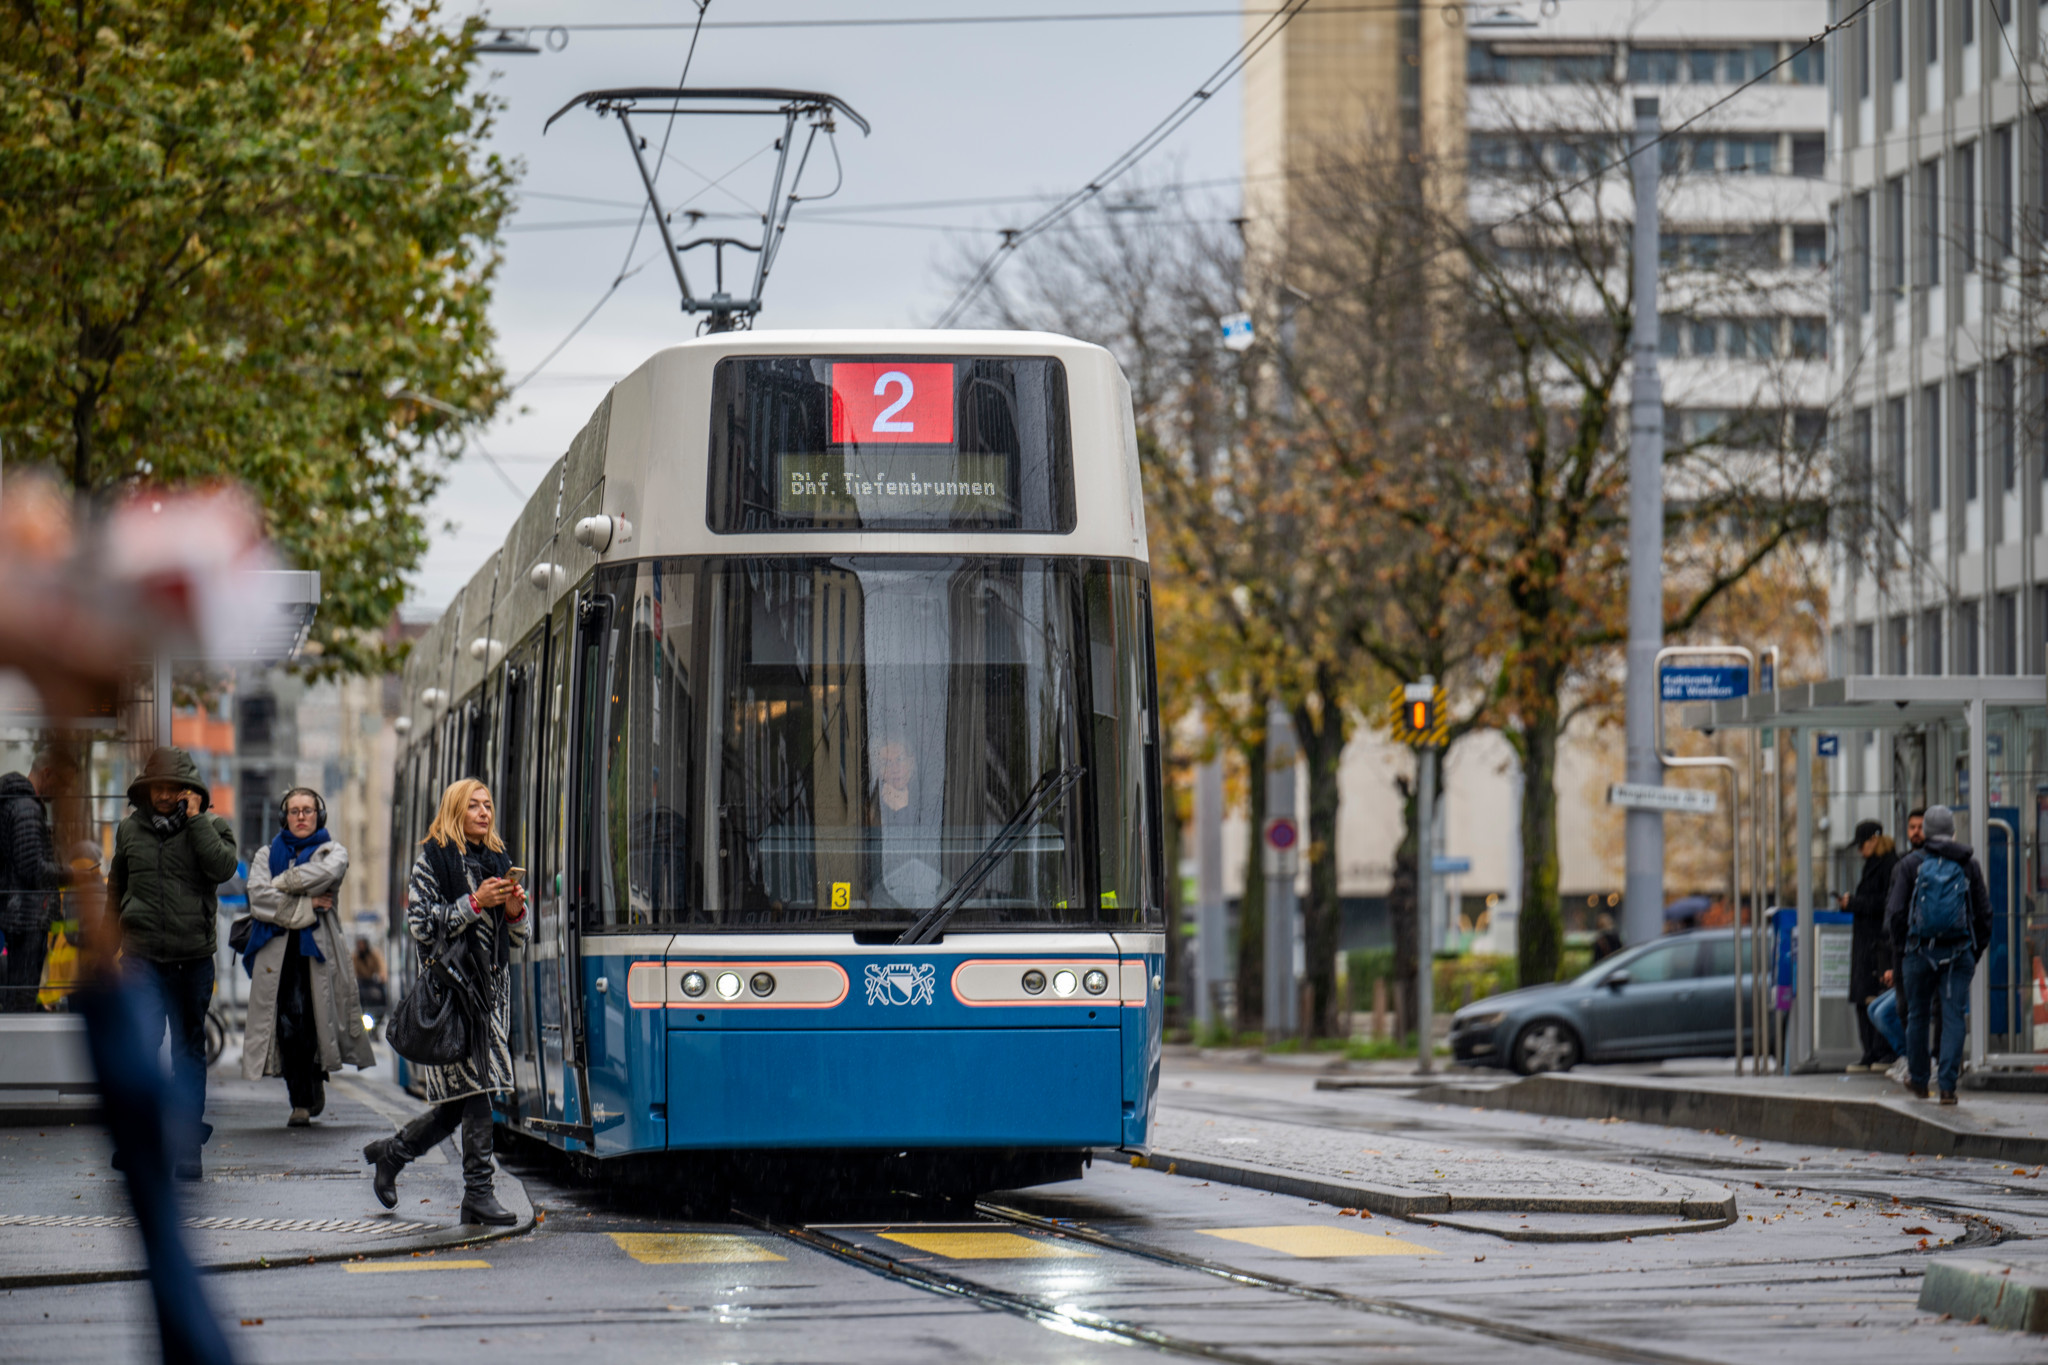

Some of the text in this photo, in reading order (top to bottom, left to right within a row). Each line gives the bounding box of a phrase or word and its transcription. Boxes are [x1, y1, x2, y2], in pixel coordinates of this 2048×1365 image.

[872, 371, 915, 433] 2
[791, 472, 996, 495] Bhf. Tiefenbrunnen
[834, 887, 848, 908] 3
